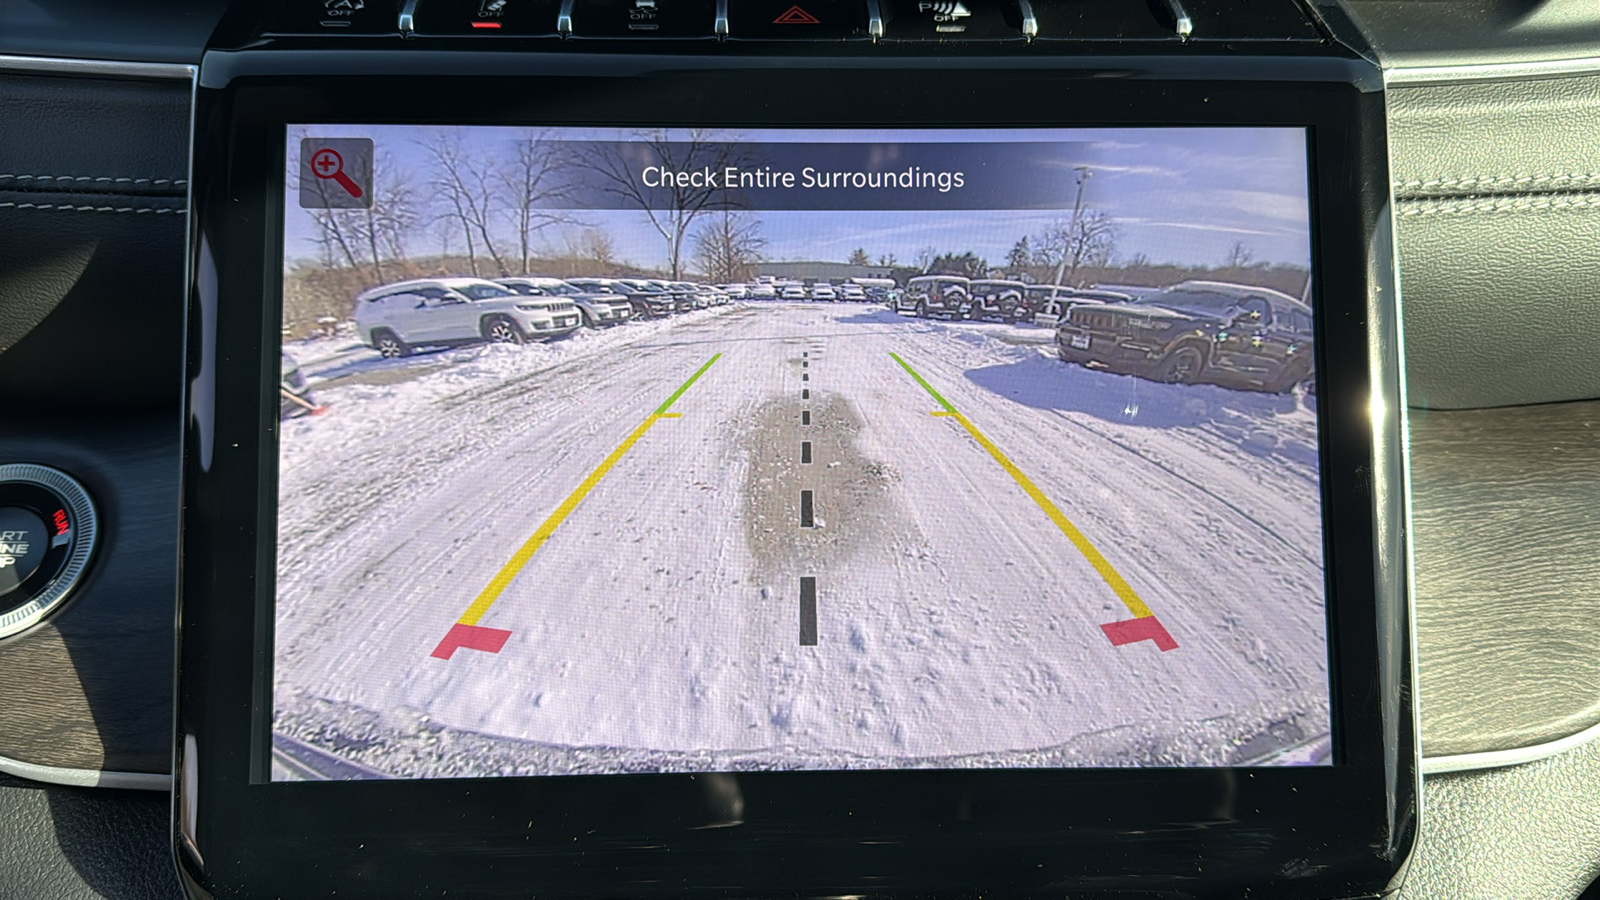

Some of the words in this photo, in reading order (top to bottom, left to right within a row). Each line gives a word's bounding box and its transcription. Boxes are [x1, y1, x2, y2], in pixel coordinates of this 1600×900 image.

[642, 166, 717, 187] Check
[724, 167, 795, 187] Entire
[801, 166, 965, 192] Surroundings
[0, 530, 29, 540] RT
[52, 509, 69, 535] RUN
